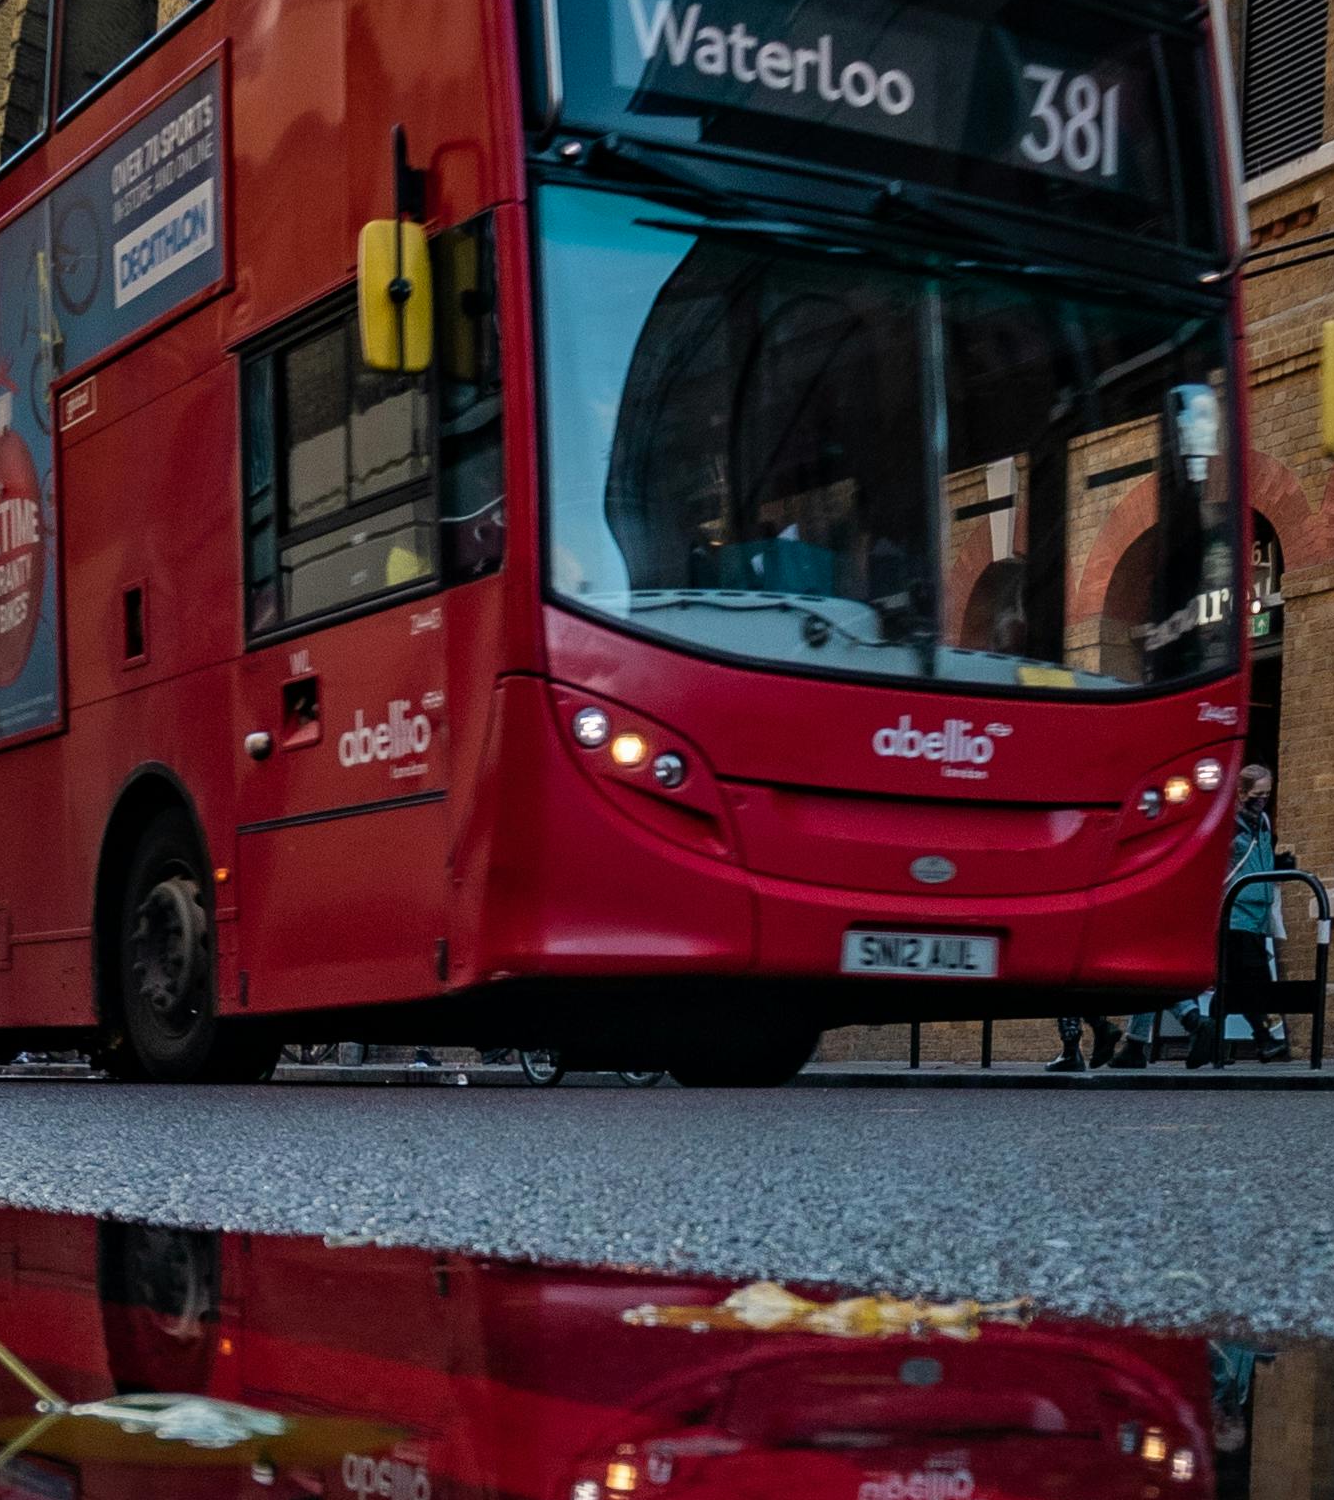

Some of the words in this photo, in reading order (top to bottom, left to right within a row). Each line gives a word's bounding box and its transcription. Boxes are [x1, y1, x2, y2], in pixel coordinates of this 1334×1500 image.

[1020, 63, 1120, 177] 381
[121, 199, 208, 289] DECATHLON
[338, 699, 432, 767] abellio
[872, 714, 995, 764] abellio
